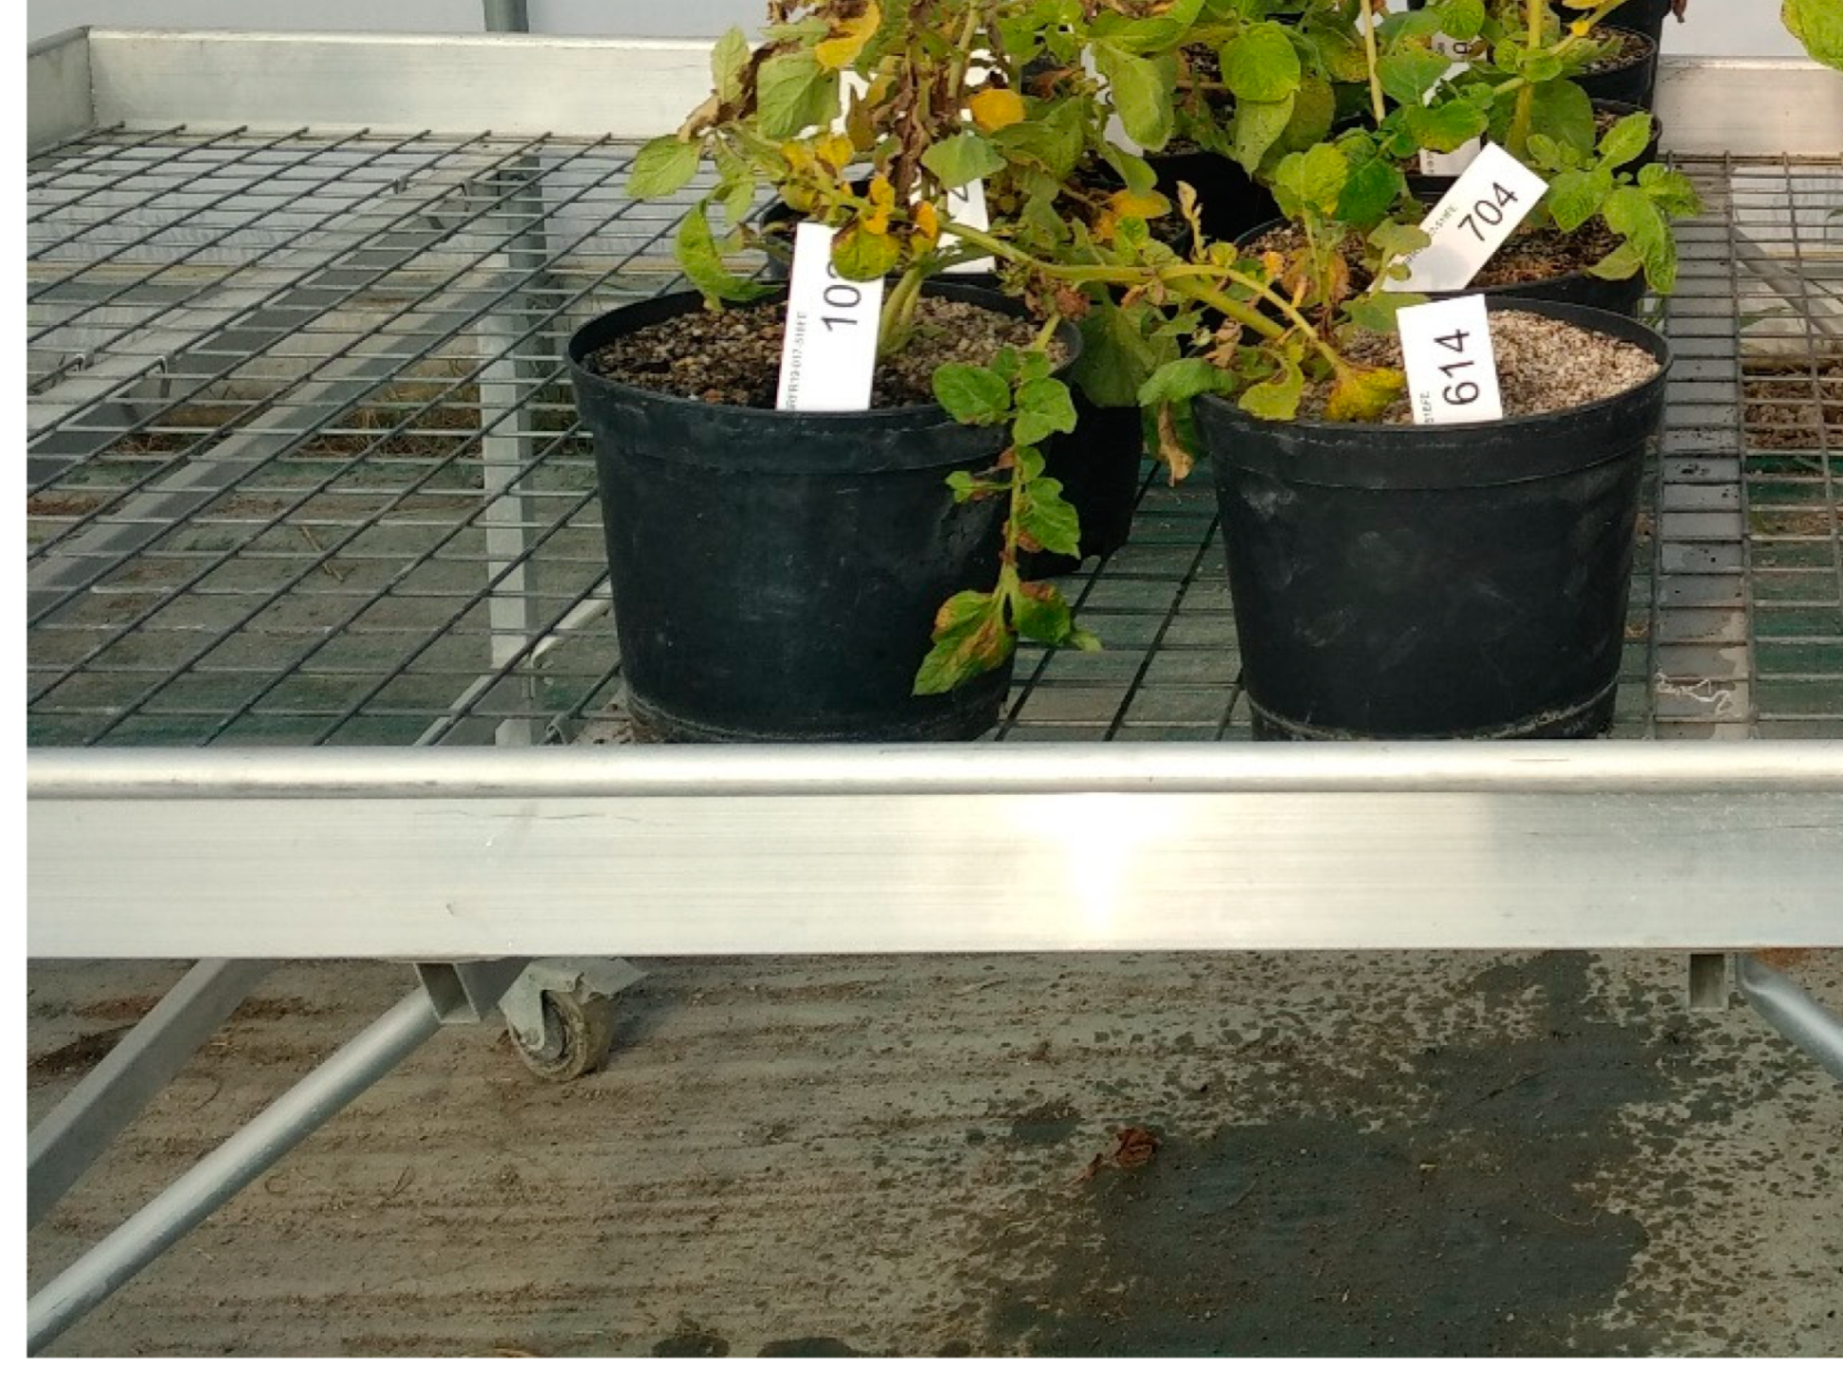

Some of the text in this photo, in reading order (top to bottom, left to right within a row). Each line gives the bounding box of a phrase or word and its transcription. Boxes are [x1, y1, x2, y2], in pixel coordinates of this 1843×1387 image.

[1457, 181, 1519, 243] 704
[822, 263, 863, 334] 10
[1437, 328, 1479, 406] 614
